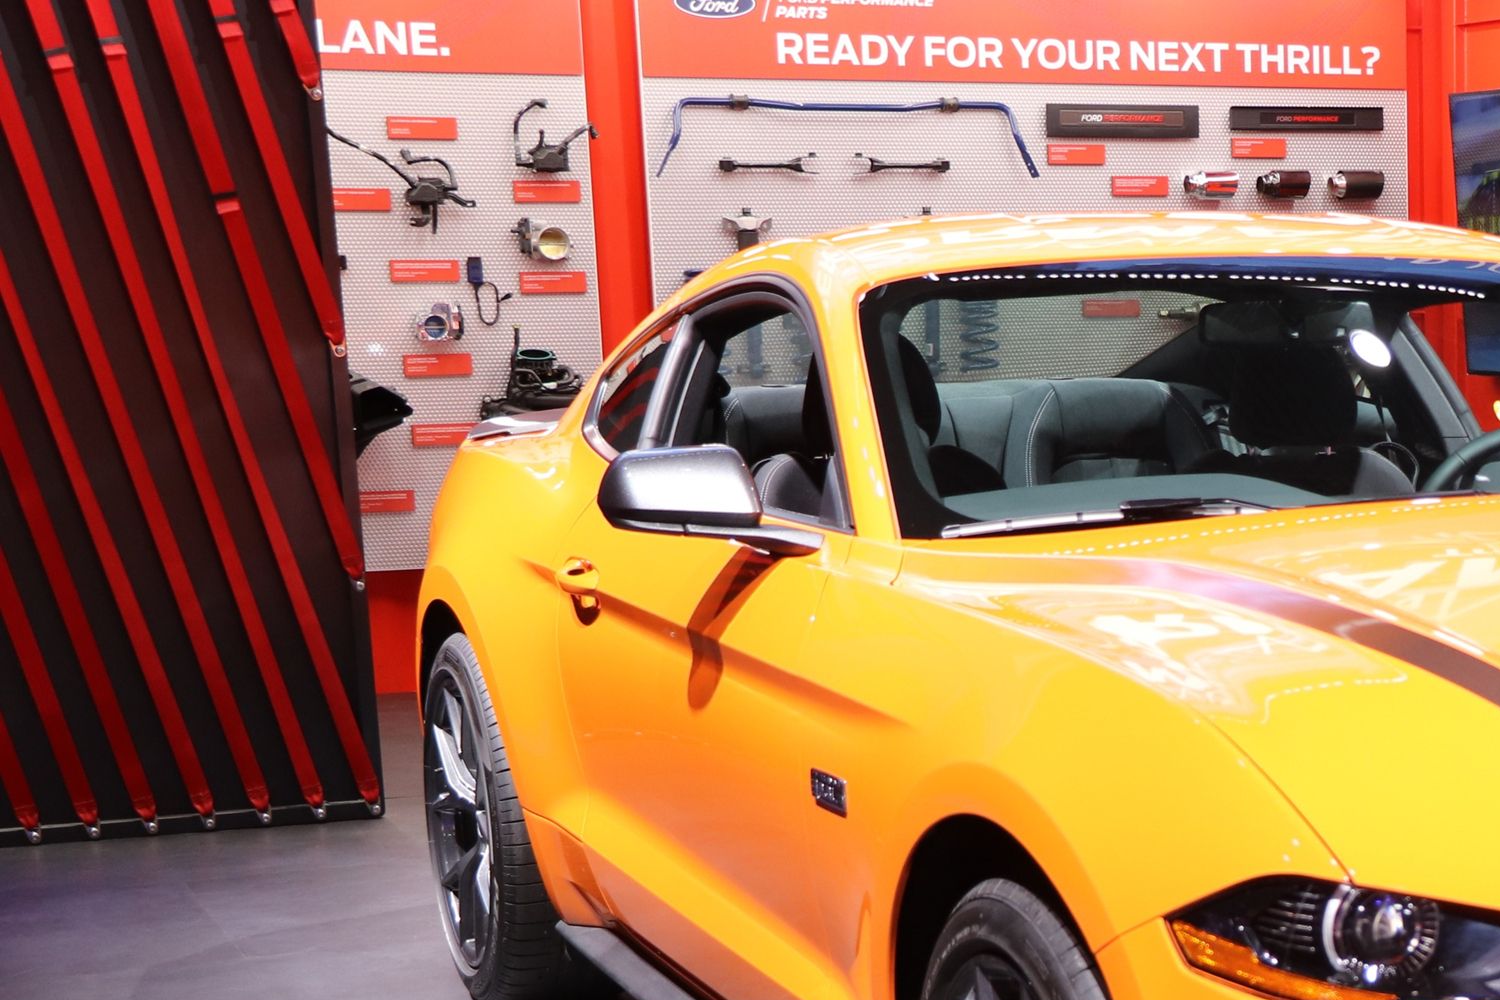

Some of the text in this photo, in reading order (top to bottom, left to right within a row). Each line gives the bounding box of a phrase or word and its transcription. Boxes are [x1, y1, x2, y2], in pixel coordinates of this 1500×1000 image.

[775, 6, 828, 20] PARTS
[316, 18, 451, 56] LANE.
[776, 32, 1381, 76] READY FOR YOUR NEXT THRILL?
[1081, 114, 1103, 122] FORD
